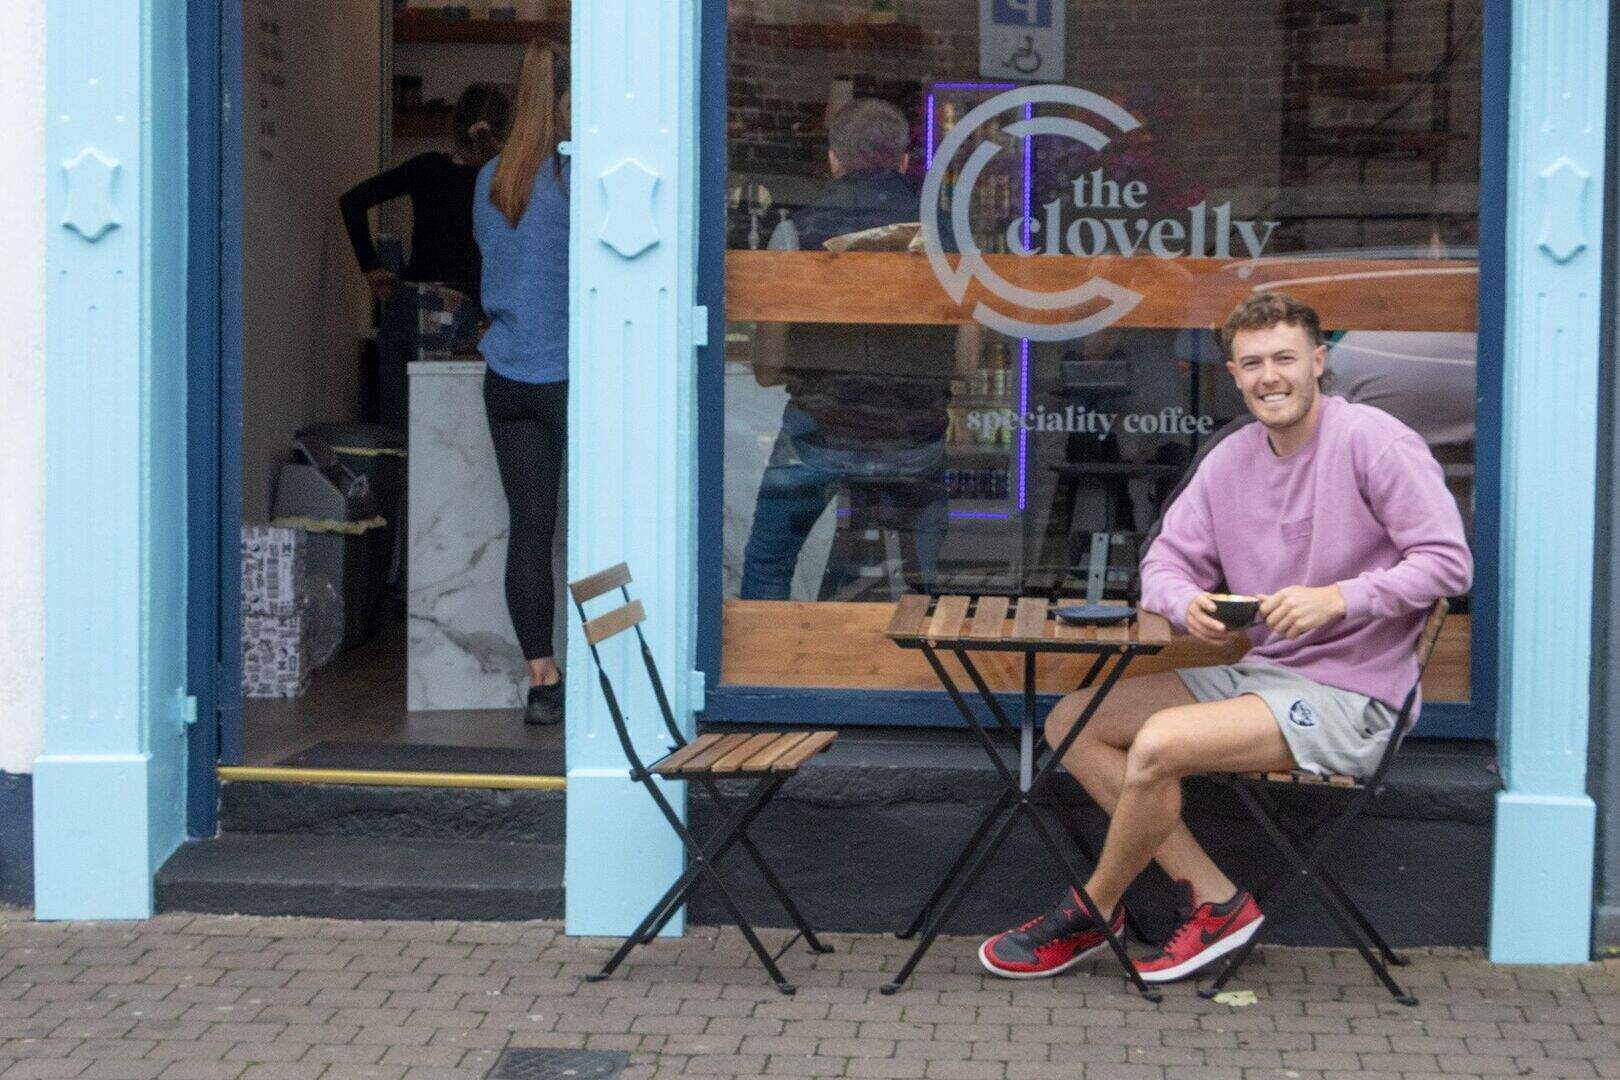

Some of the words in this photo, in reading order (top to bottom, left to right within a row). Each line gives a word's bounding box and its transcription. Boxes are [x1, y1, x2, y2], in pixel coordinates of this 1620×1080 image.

[1071, 167, 1149, 209] the
[1006, 197, 1281, 279] clovelly
[966, 405, 1118, 441] speciality
[1123, 406, 1215, 435] coffee
